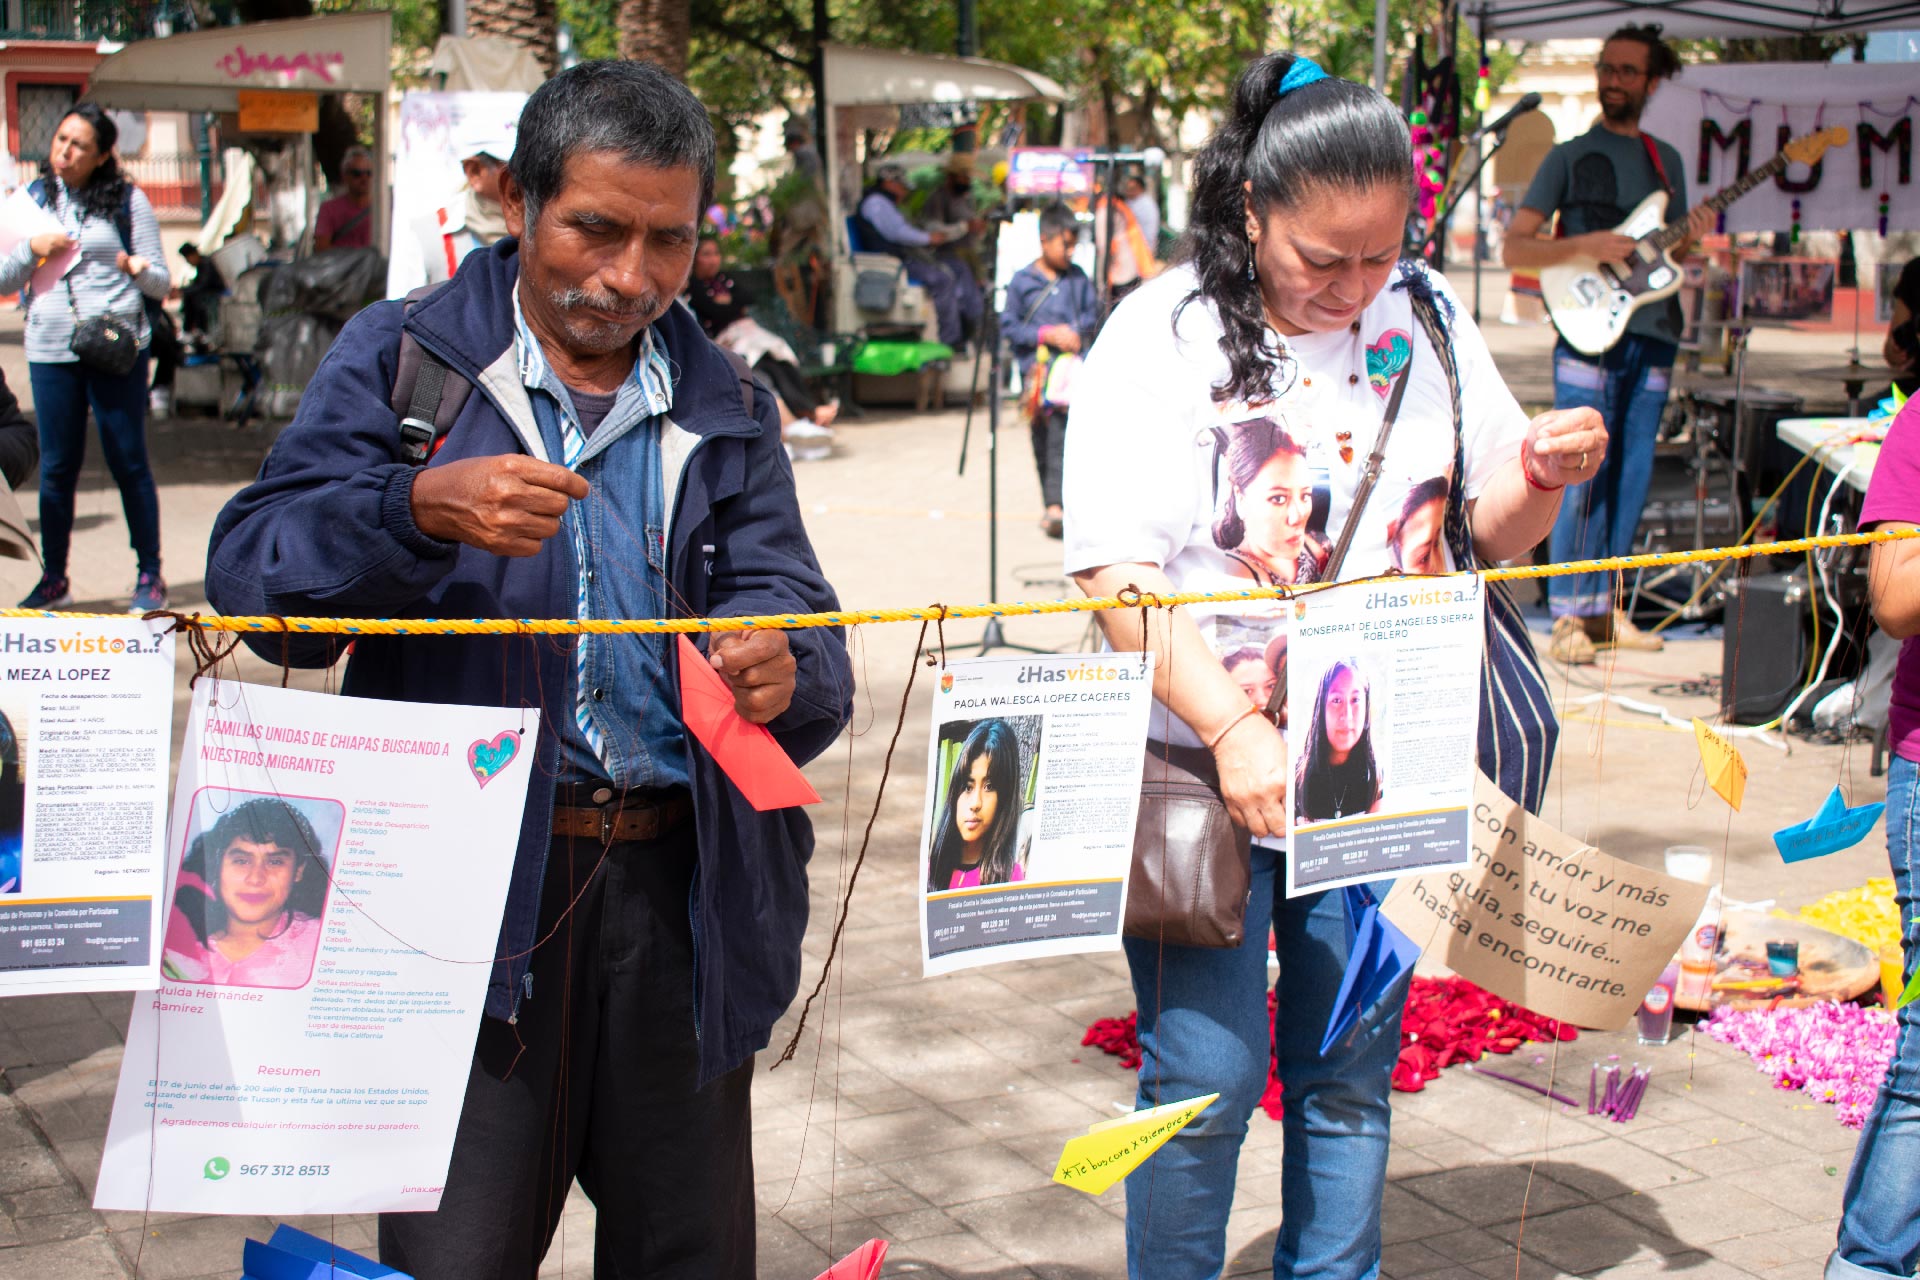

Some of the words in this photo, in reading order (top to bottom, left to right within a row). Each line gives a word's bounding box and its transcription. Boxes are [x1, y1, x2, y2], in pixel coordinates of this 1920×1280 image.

[1300, 623, 1355, 637] MONSERRAT
[1358, 622, 1371, 631] DE
[1374, 620, 1392, 630] LOS
[1394, 616, 1438, 628] ANGELES
[1440, 613, 1474, 624] SIERRA
[1363, 629, 1408, 641] ROBLERO
[7, 668, 52, 681] MEZA
[58, 668, 111, 681] LOPEZ
[954, 697, 987, 710] PAOLA
[990, 695, 1040, 706] WALESCA
[1043, 693, 1077, 704] LOPEZ
[1080, 692, 1130, 702] CACERES
[205, 717, 262, 740] FAMILIAS
[265, 725, 309, 745] UNIDAS
[312, 731, 328, 747] DE
[330, 733, 380, 752] CHIAPAS
[382, 738, 439, 757] BUSCANDO
[441, 742, 449, 757] A
[201, 744, 265, 768] NUESTROS
[265, 752, 335, 775] MIGRANTES
[1474, 803, 1517, 845] Con
[1522, 842, 1592, 883] amor
[1592, 875, 1615, 893] y
[1616, 879, 1670, 908] más
[1529, 879, 1557, 905] tu
[1563, 898, 1609, 925] voz
[1611, 917, 1652, 937] me
[1447, 872, 1504, 920] guía,
[1510, 912, 1621, 965] seguiré...
[1412, 879, 1473, 936] hasta
[1477, 932, 1627, 998] encontrarte.
[196, 988, 264, 1002] Hernández
[152, 1001, 204, 1014] Ramírez
[257, 1064, 321, 1077] Resumen
[184, 1082, 206, 1090] junio
[298, 1086, 328, 1095] Tijuana
[368, 1087, 398, 1095] Estados
[146, 1091, 186, 1099] cruzando
[310, 1097, 324, 1105] fue
[160, 1118, 230, 1128] Agradecemos
[232, 1121, 278, 1130] cualquier
[279, 1121, 335, 1130] información
[337, 1122, 363, 1130] sobre
[378, 1123, 421, 1131] paradero.
[240, 1164, 268, 1176] 967
[271, 1164, 295, 1176] 312
[298, 1164, 330, 1176] 8513
